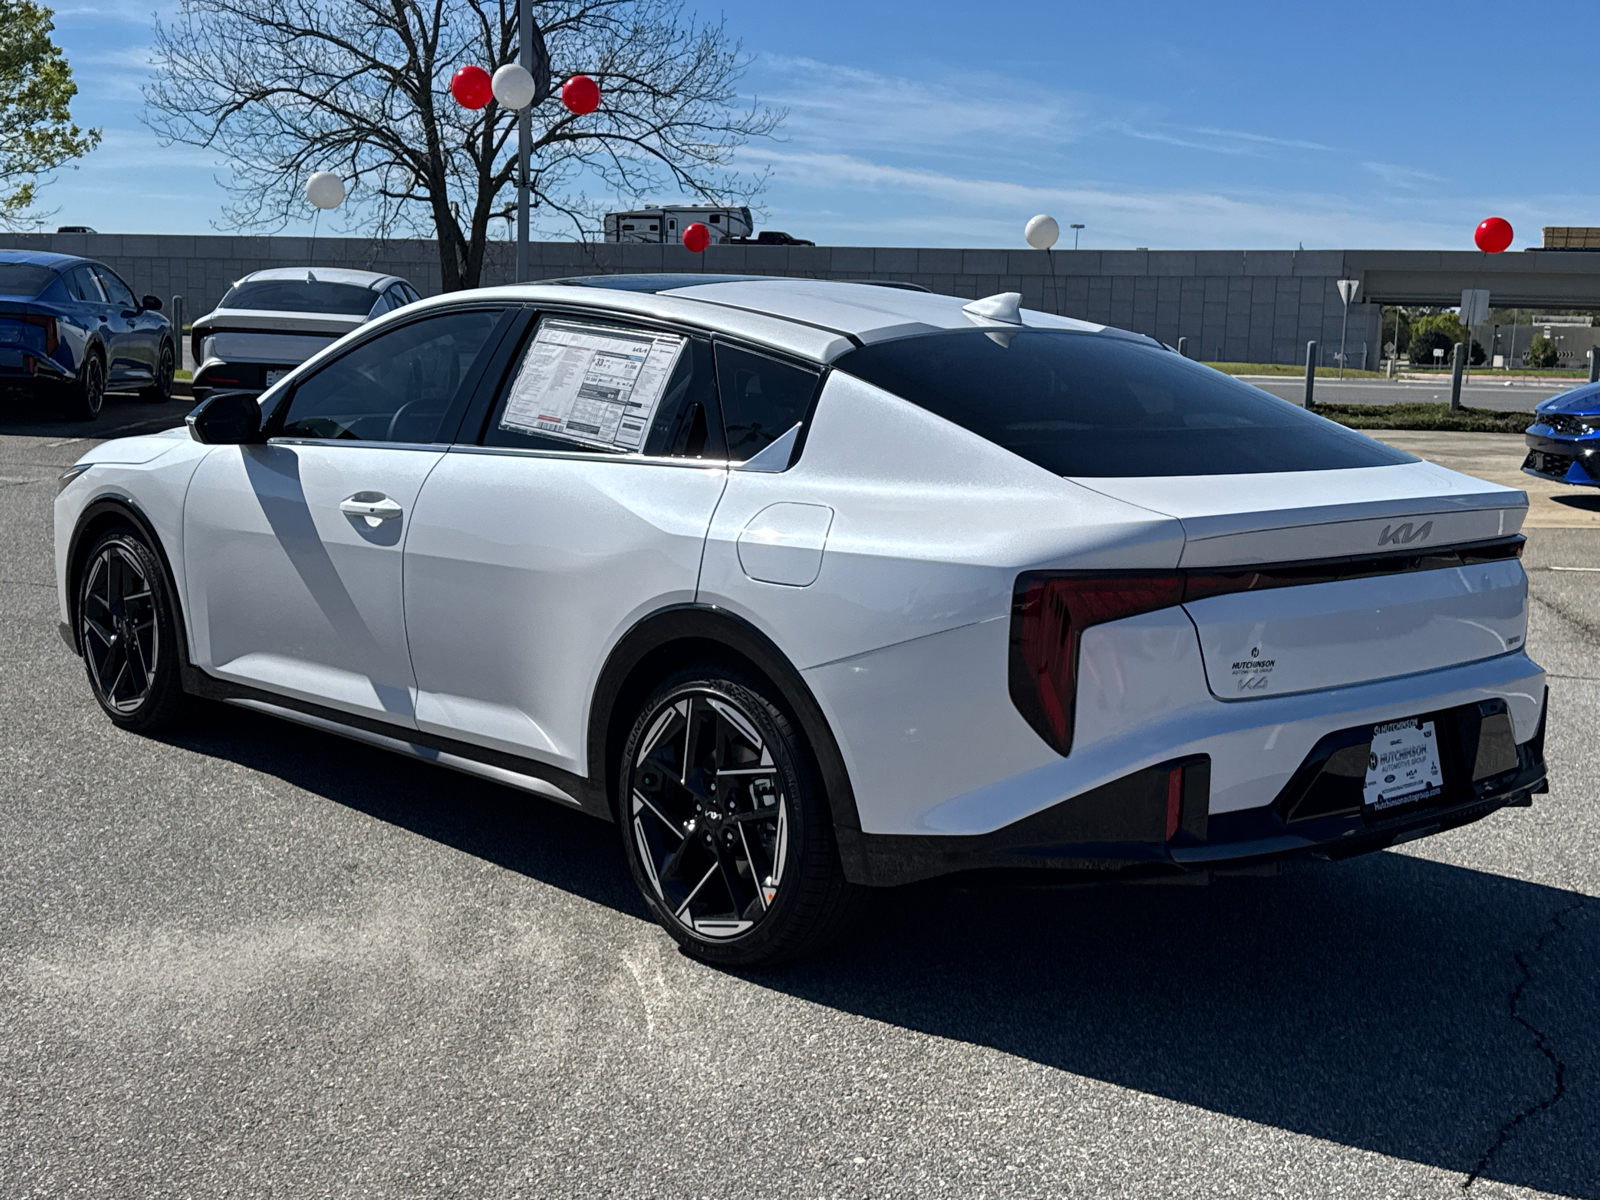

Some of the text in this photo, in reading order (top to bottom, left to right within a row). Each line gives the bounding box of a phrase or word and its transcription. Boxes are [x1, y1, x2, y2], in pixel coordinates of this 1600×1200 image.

[1378, 521, 1433, 546] KIA
[1232, 660, 1275, 669] HUTCHINSON
[1237, 676, 1268, 691] K4
[626, 701, 654, 757] KUMHO
[1381, 718, 1418, 734] HUTCHINSON
[1380, 744, 1427, 765] HUTCHINSON
[1382, 756, 1427, 773] AUTOMOTIVE GROUP
